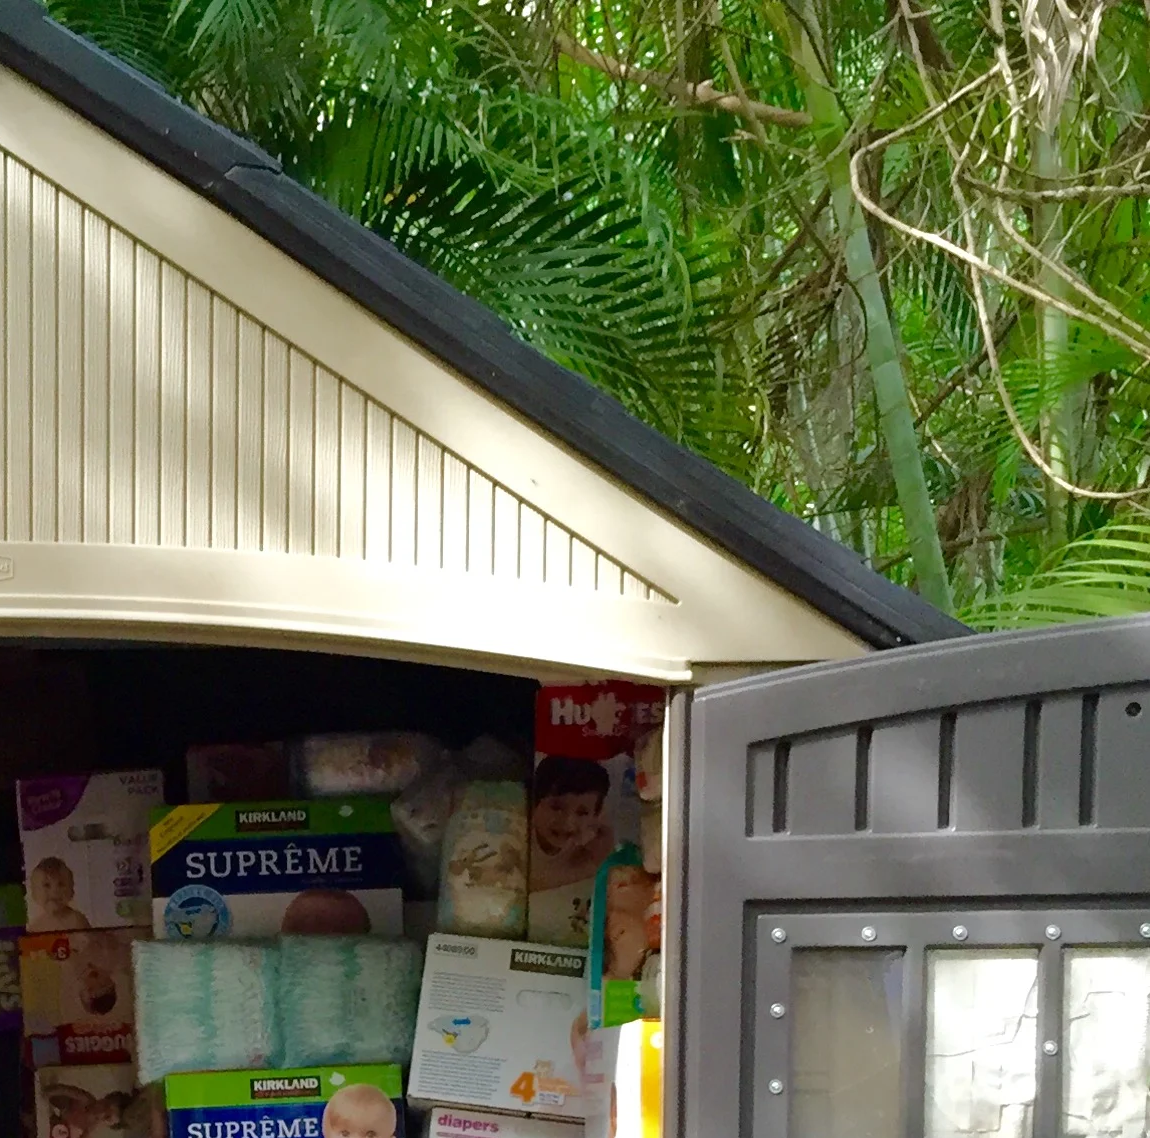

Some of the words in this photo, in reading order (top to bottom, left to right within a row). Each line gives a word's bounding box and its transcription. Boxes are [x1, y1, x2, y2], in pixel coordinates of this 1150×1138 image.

[239, 809, 306, 823] KIRKLAND
[185, 842, 363, 880] SUPRÊME
[514, 951, 583, 969] KIRKLAND
[64, 1035, 131, 1053] UGGIES
[253, 1078, 318, 1091] KIRKLAND
[510, 1072, 537, 1101] 4
[438, 1114, 499, 1133] diapers
